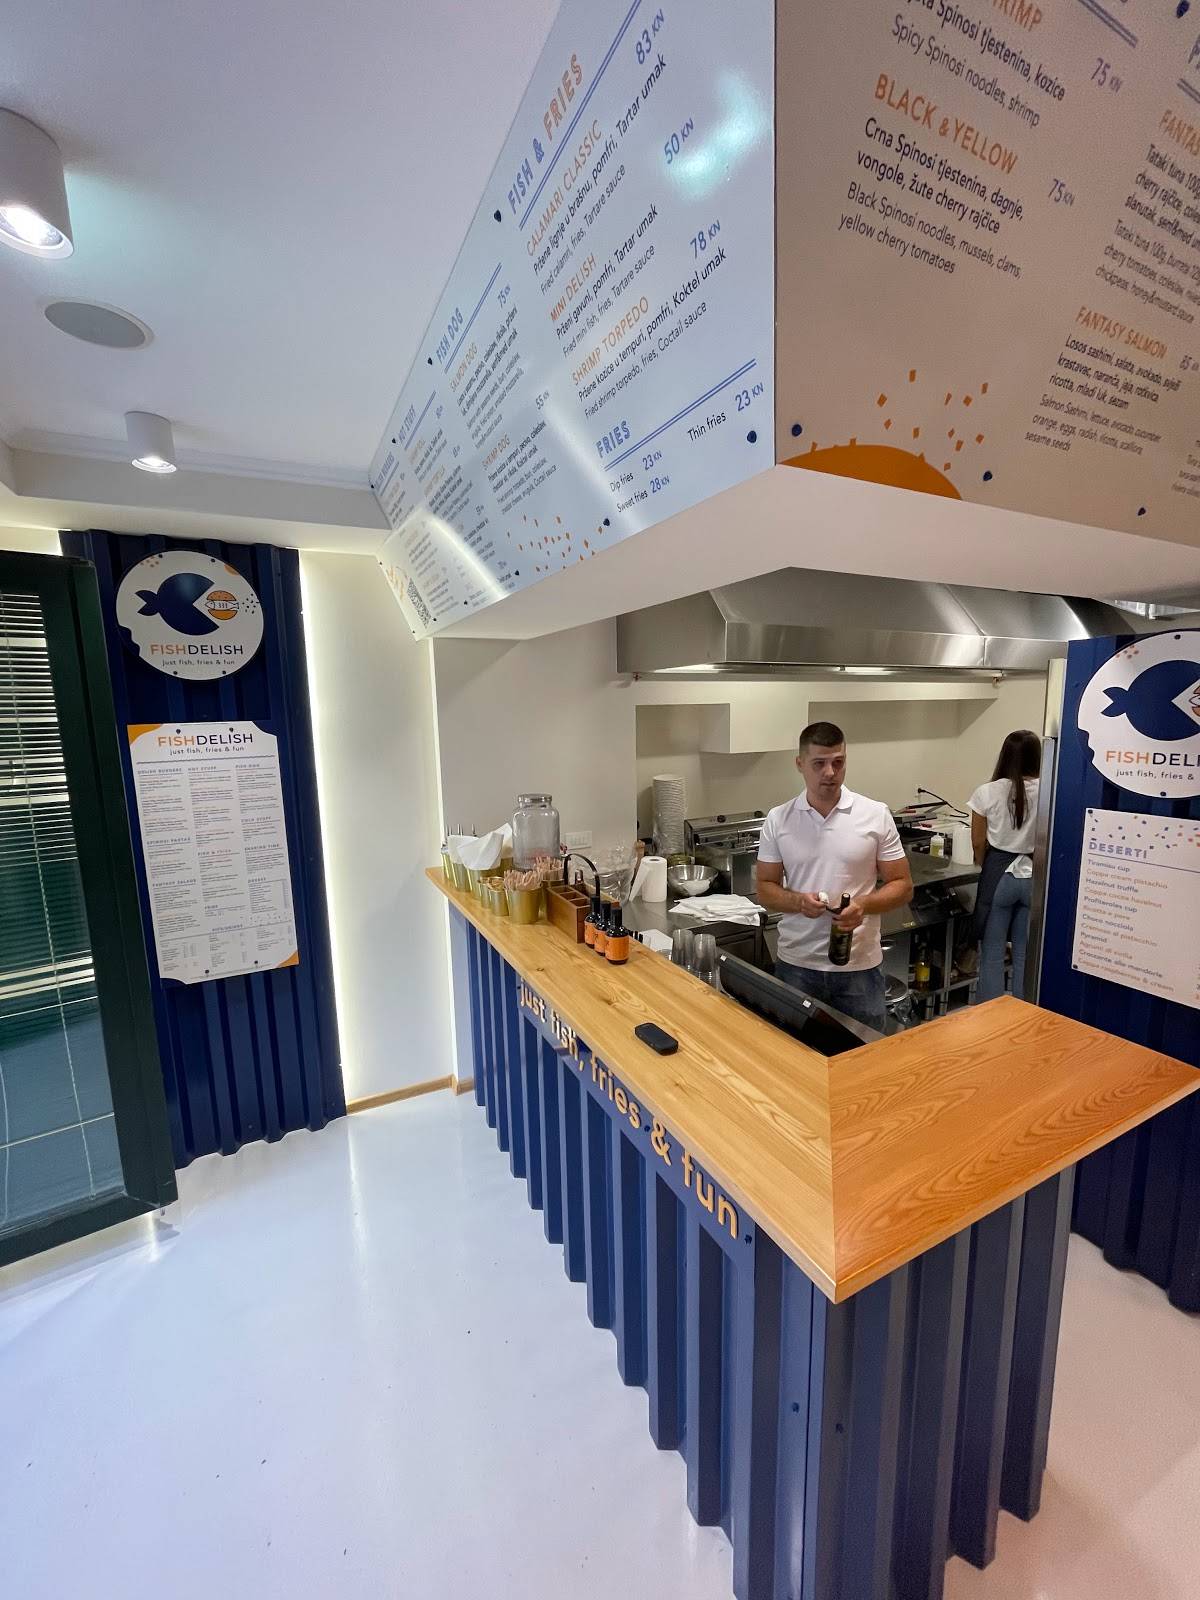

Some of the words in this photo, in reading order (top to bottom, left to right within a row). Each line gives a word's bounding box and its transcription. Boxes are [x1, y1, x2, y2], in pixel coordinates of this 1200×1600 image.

[636, 30, 652, 64] 83
[652, 9, 664, 35] KN
[937, 0, 982, 40] Spinosi
[980, 25, 1032, 82] tjestenina,
[1034, 64, 1065, 101] kozice
[892, 14, 924, 55] Spicy
[924, 36, 966, 76] Spinosi
[965, 68, 1005, 109] noodles,
[1008, 95, 1040, 129] shrimp
[1091, 58, 1111, 86] 75
[508, 158, 534, 214] FISH
[533, 138, 544, 164] &
[544, 54, 582, 142] FRIES
[570, 180, 592, 217] brašnu,
[592, 136, 619, 180] pomfri,
[616, 100, 640, 138] Tartar
[642, 54, 666, 98] umak
[664, 133, 679, 164] 50
[681, 118, 694, 142] KN
[874, 73, 937, 129] BLACK
[938, 117, 949, 136] &
[953, 118, 1017, 174] YELLOW
[527, 192, 564, 256] CALAMARI
[564, 120, 602, 190] CLASSIC
[584, 198, 606, 228] Tartare
[606, 164, 626, 198] sauce
[858, 150, 906, 190] vongole,
[909, 173, 933, 199] žute
[935, 190, 968, 221] cherry
[969, 209, 1000, 234] rajčice
[865, 117, 893, 147] Crna
[895, 134, 938, 169] Spinosi
[938, 158, 987, 202] tjestenina,
[990, 188, 1023, 220] dagnje,
[1048, 178, 1066, 202] 75
[593, 260, 616, 298] pomfri,
[614, 234, 635, 264] Tartar
[636, 204, 658, 238] umak
[690, 231, 707, 260] 78
[708, 220, 721, 242] KN
[838, 212, 875, 238] yellow
[876, 228, 910, 257] cherry
[910, 243, 955, 274] tomatoes
[848, 181, 876, 211] Black
[878, 196, 918, 227] Spinosi
[917, 218, 956, 248] noodles,
[959, 238, 994, 266] mussels,
[997, 257, 1021, 279] clams,
[550, 296, 567, 321] MINI
[566, 252, 596, 301] DELISH
[597, 297, 613, 316] fries,
[611, 270, 634, 299] Tartare
[635, 245, 655, 274] sauce
[436, 334, 450, 364] FISH
[448, 307, 463, 341] DOG
[572, 347, 601, 386] SHRIMP
[602, 296, 649, 352] TORPEDO
[596, 361, 614, 385] kozice
[619, 330, 647, 365] tempuri,
[646, 302, 674, 340] pomfri,
[672, 270, 700, 309] Koktel
[701, 247, 727, 280] umak
[1065, 334, 1088, 355] Losos
[1075, 306, 1126, 340] FANTASY
[1125, 329, 1167, 359] SALMON
[616, 363, 643, 393] torpedo,
[642, 348, 658, 368] fries,
[658, 321, 684, 352] Coctail
[684, 301, 706, 328] sauce
[596, 420, 630, 458] FRIES
[688, 426, 706, 443] Thin
[706, 412, 727, 431] fries
[735, 390, 750, 412] 23
[752, 382, 764, 397] KN
[610, 480, 620, 493] Dip
[620, 472, 633, 487] fries
[642, 455, 654, 471] 23
[617, 497, 634, 512] Sweet
[634, 489, 648, 503] fries
[650, 478, 662, 493] 28
[151, 644, 243, 655] FISHDELISH
[162, 659, 176, 667] just
[158, 734, 253, 747] FISHDELISH
[170, 748, 184, 756] just
[1116, 769, 1133, 777] just
[1137, 770, 1156, 779] fish,
[1161, 771, 1183, 780] fries
[1089, 842, 1147, 858] DESERTI
[519, 979, 546, 1022] just
[550, 1010, 585, 1071] fish,
[590, 1053, 641, 1128] fries
[651, 1116, 672, 1166] &
[682, 1151, 738, 1240] fun
